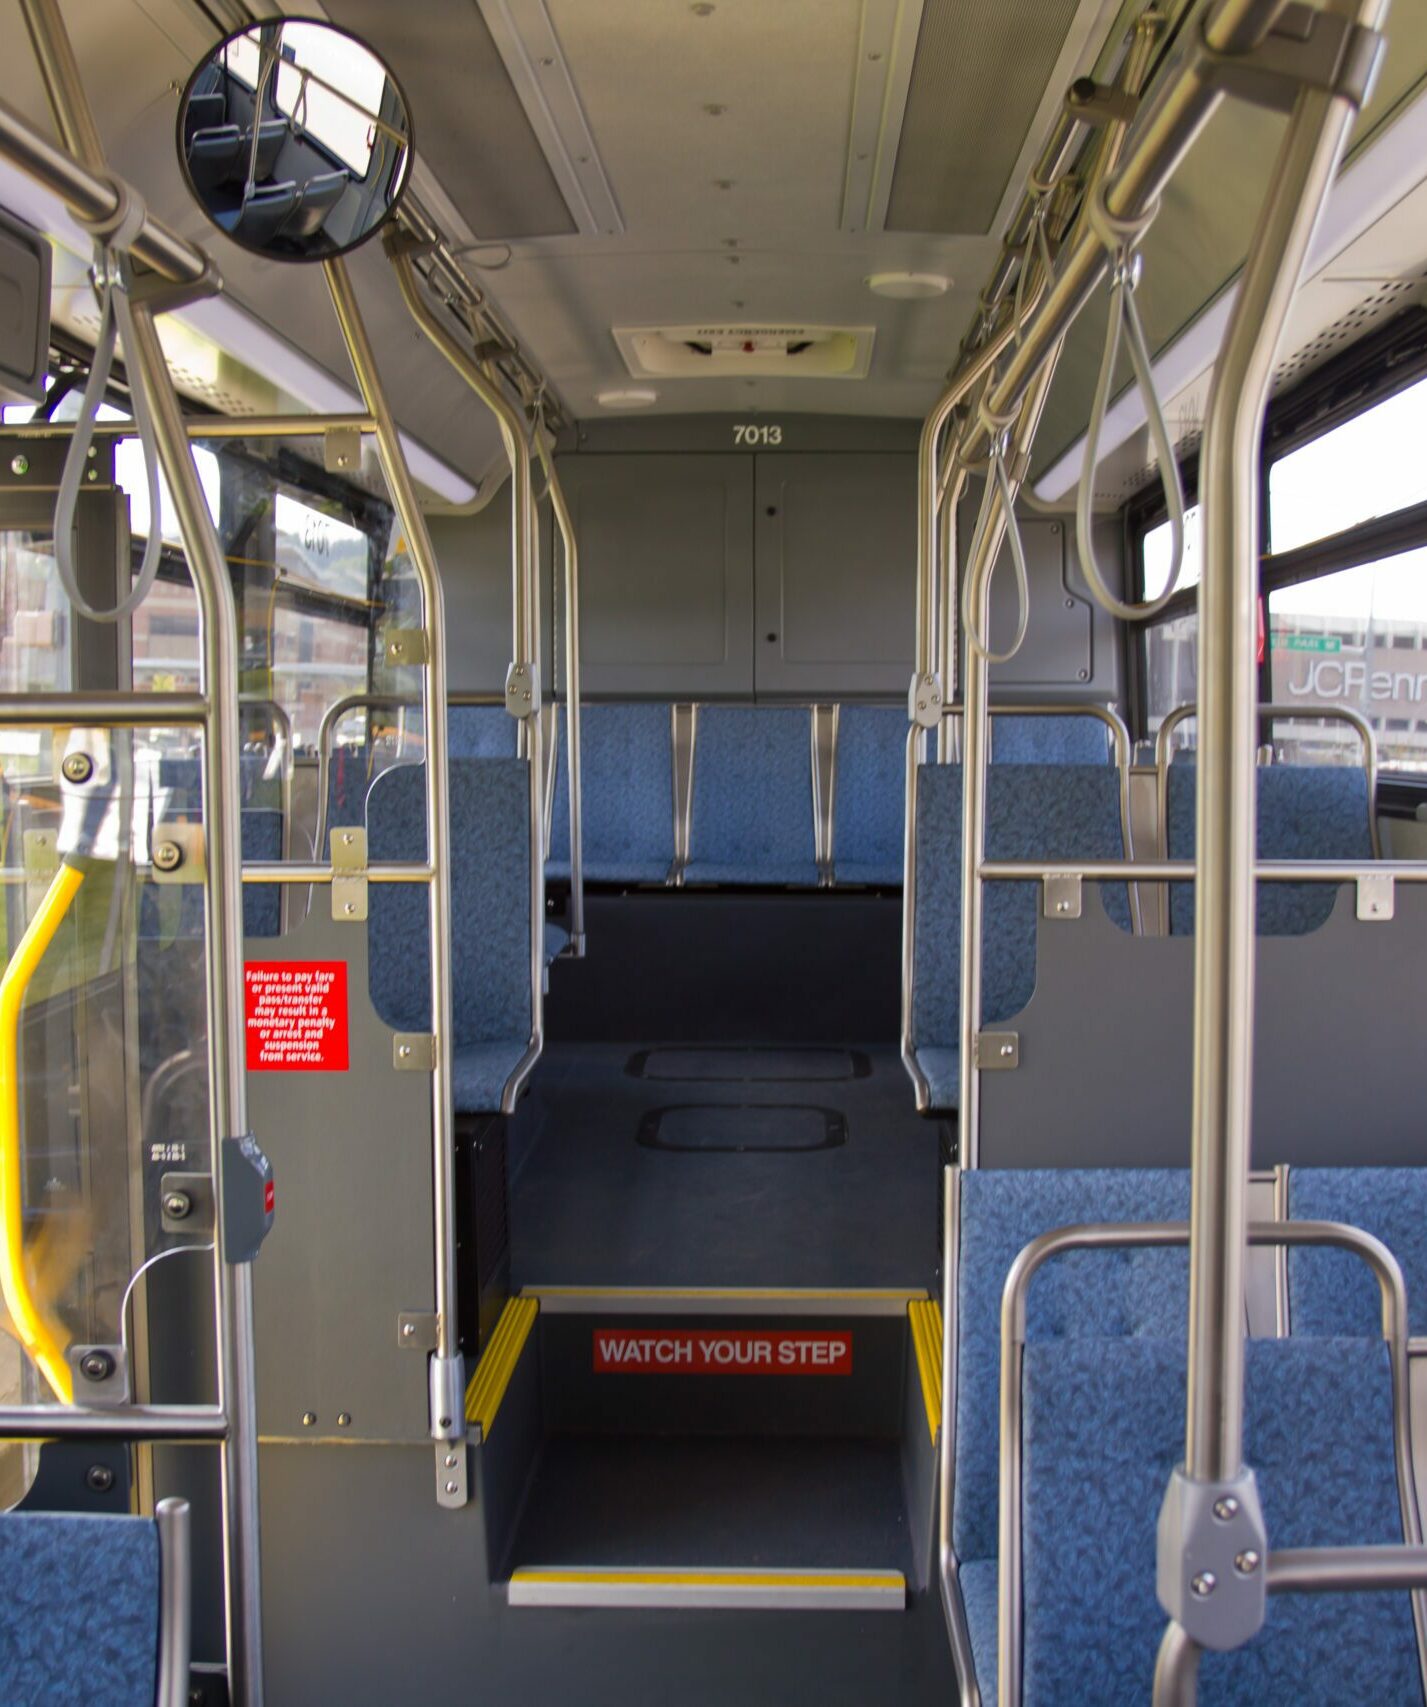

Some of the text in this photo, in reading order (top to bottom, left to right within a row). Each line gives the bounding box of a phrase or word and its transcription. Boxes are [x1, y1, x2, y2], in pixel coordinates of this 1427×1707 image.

[733, 425, 782, 445] 7013
[246, 970, 335, 985] Failure to pay fare
[252, 982, 330, 995] or present valid
[259, 994, 323, 1006] pass/transfer
[254, 1006, 328, 1018] may result in a
[247, 1017, 336, 1030] monetary penalty
[260, 1028, 324, 1039] or arrest and
[264, 1040, 319, 1052] suspension
[260, 1050, 324, 1062] from service.
[600, 1339, 846, 1364] WATCH YOUR STEP
